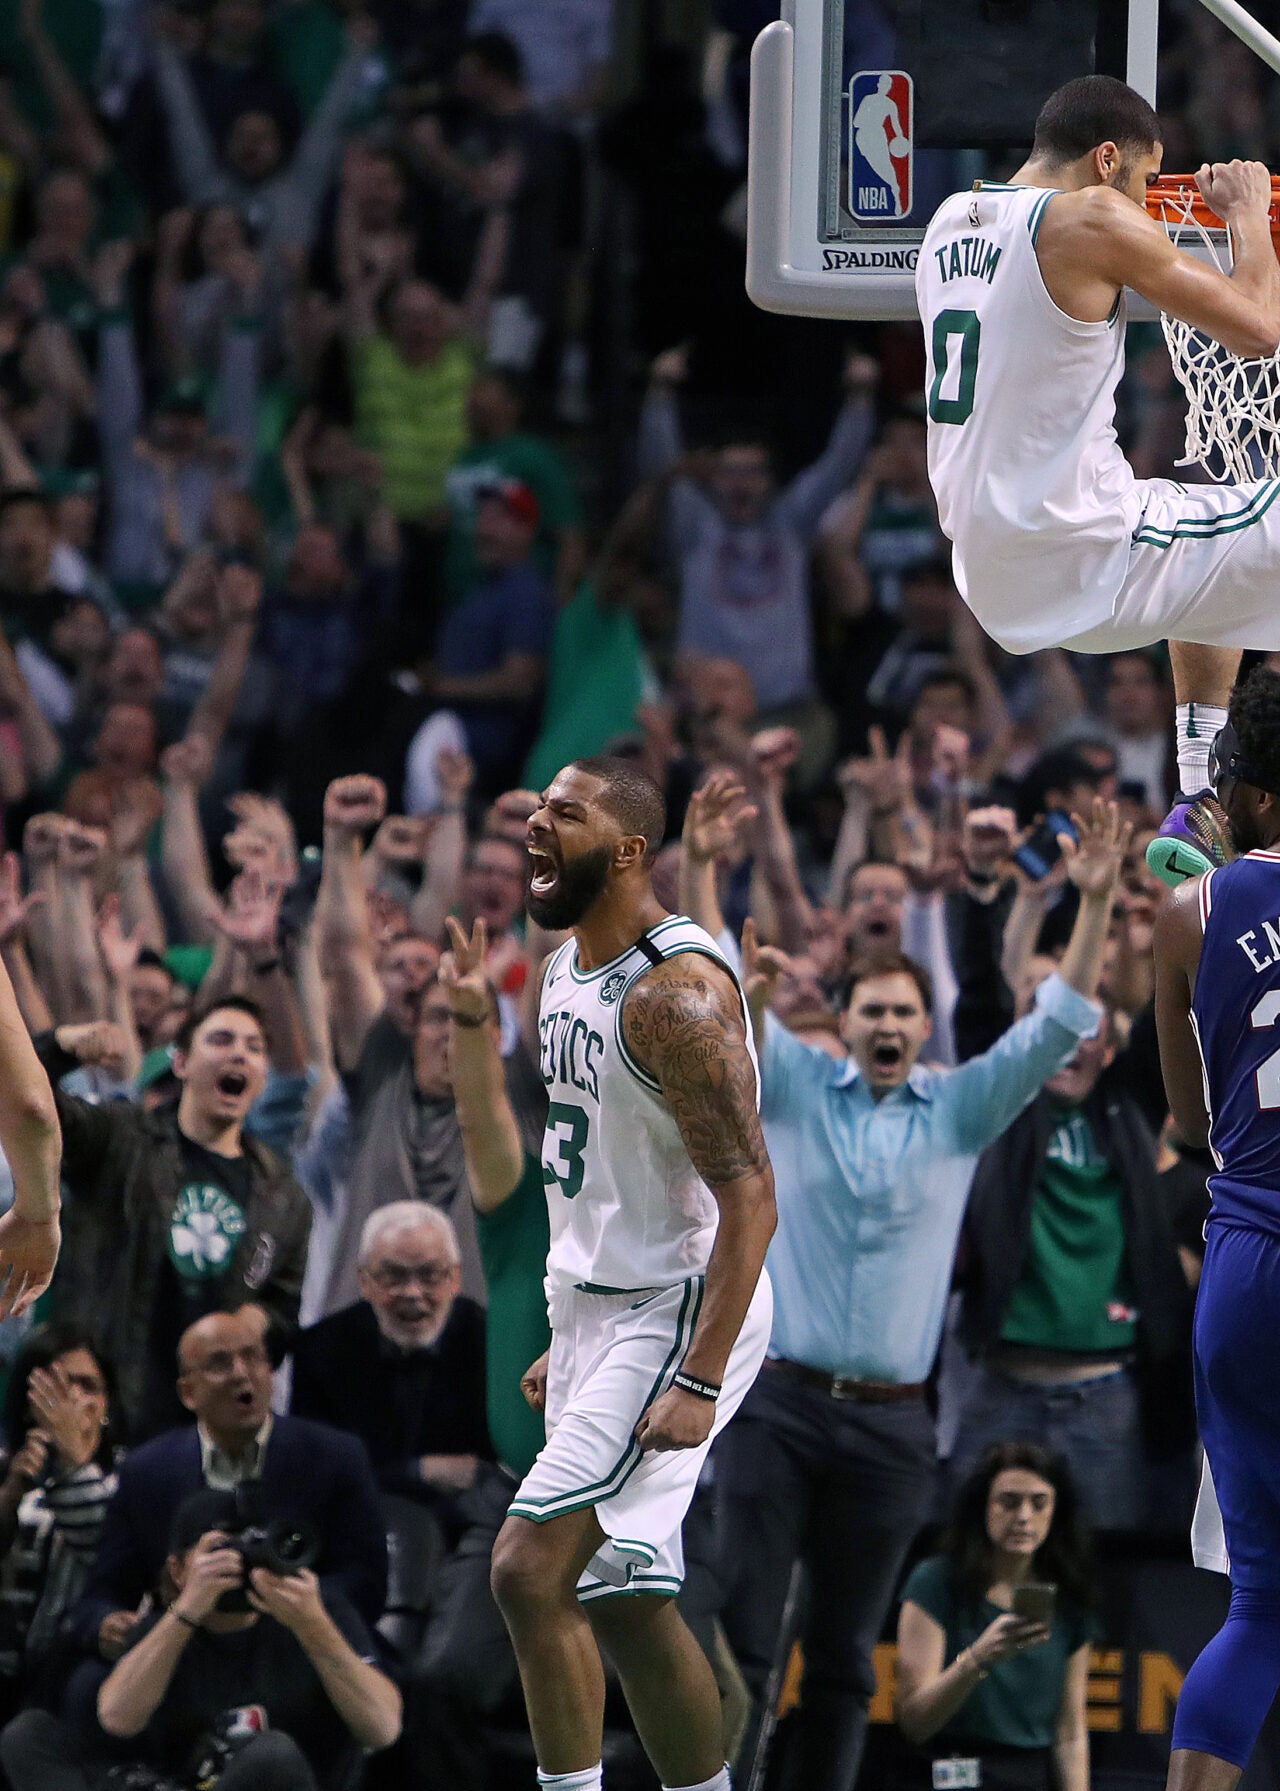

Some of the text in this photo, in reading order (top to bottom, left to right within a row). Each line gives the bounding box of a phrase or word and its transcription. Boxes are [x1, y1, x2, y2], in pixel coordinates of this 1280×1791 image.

[858, 186, 889, 211] NBA
[822, 249, 919, 272] SPALDING
[934, 237, 1002, 285] TATUM
[928, 308, 981, 426] 0
